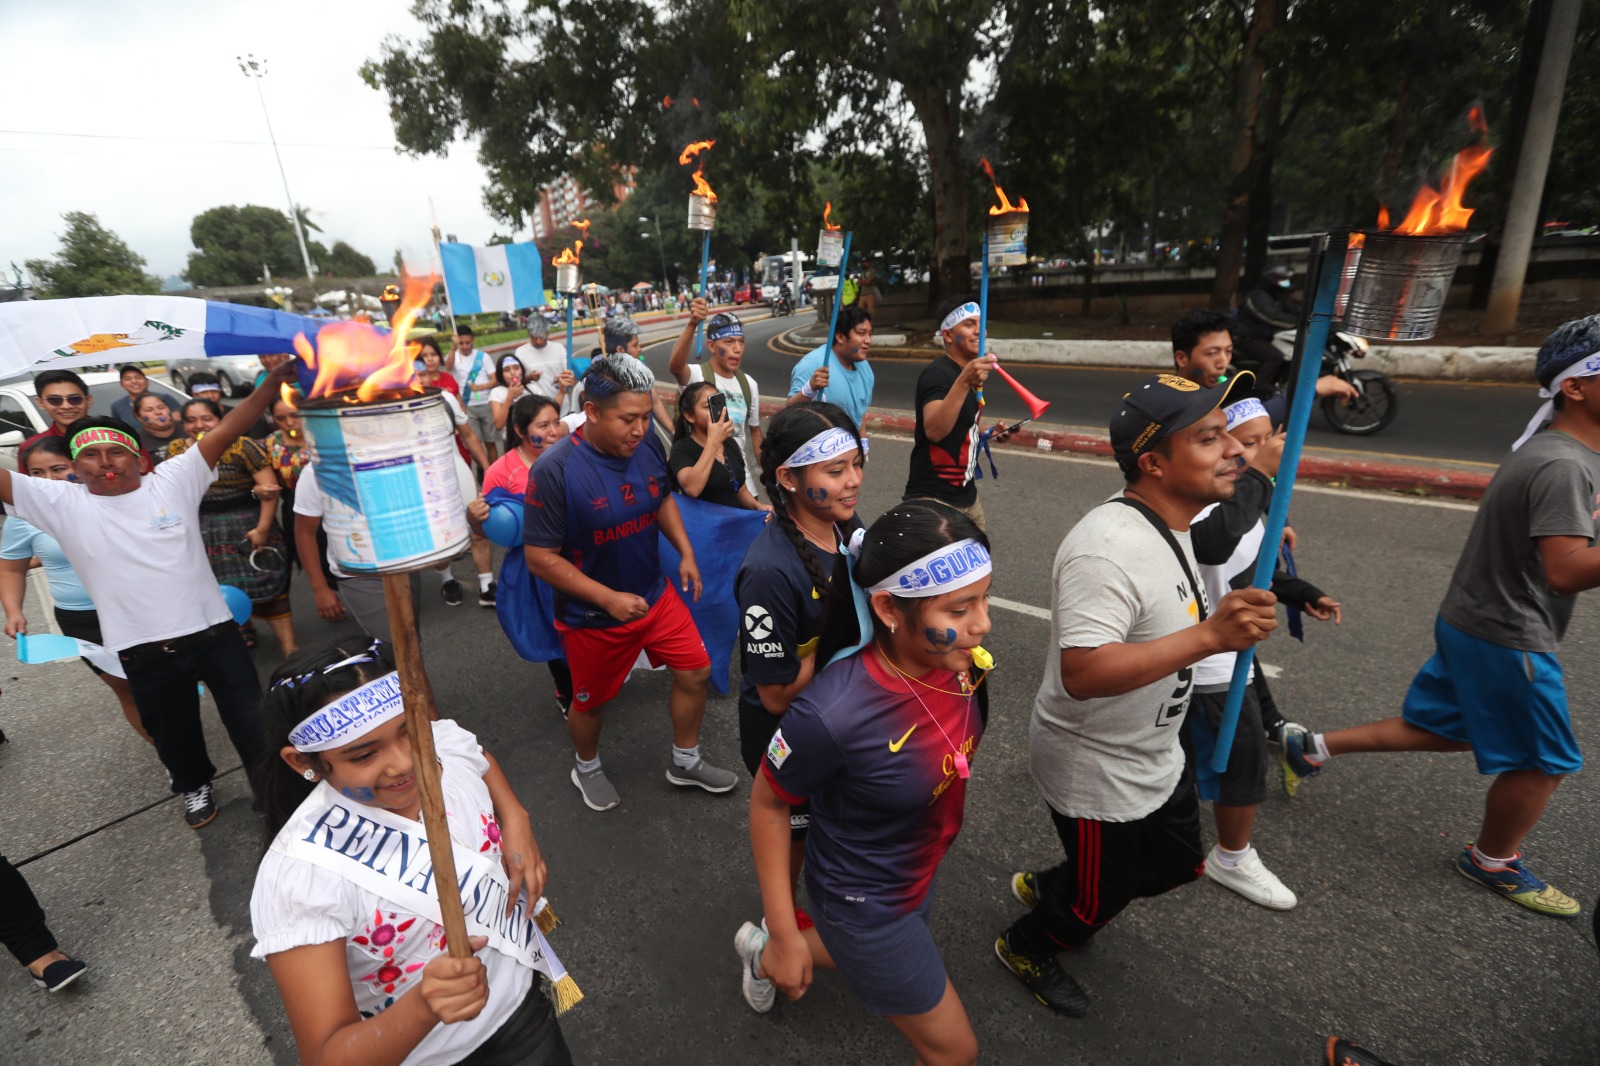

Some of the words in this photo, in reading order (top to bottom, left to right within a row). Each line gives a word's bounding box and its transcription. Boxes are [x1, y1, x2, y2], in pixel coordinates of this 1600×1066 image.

[621, 483, 635, 500] Z
[746, 642, 783, 654] AXION
[325, 727, 349, 742] SOY
[302, 804, 434, 894] REINA
